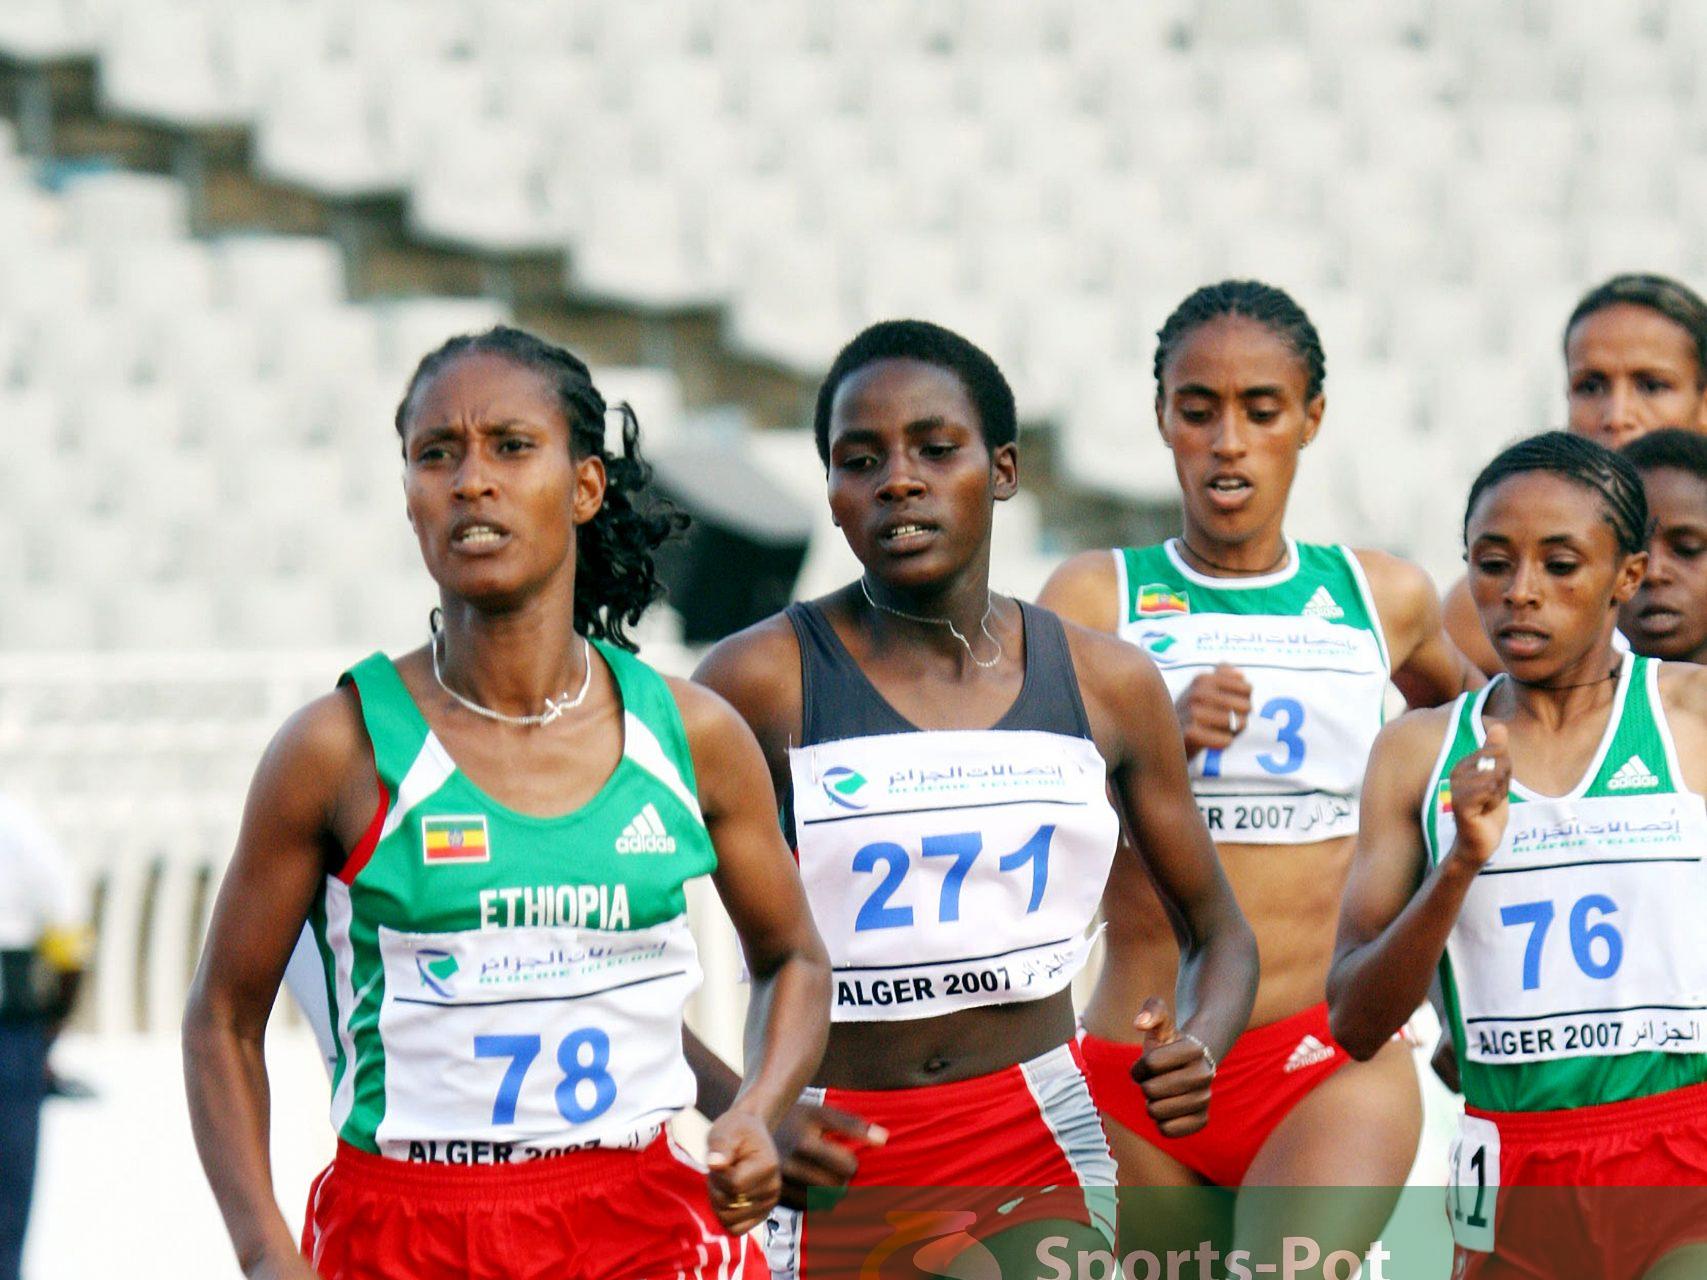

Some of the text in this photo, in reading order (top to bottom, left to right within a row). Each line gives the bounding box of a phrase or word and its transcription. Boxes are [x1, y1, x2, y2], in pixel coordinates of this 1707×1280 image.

[1606, 774, 1659, 790] adidas
[1234, 805, 1295, 829] 2007
[615, 834, 677, 855] adidas
[851, 824, 1056, 932] 271
[479, 882, 631, 931] ETHIOPIA
[1500, 893, 1624, 991] 76
[836, 966, 1013, 1007] ALGER 2007
[1563, 1022, 1623, 1049] 2007
[1630, 1018, 1701, 1047] الجزائر
[474, 1027, 618, 1127] 78
[407, 1140, 514, 1165] ALGER
